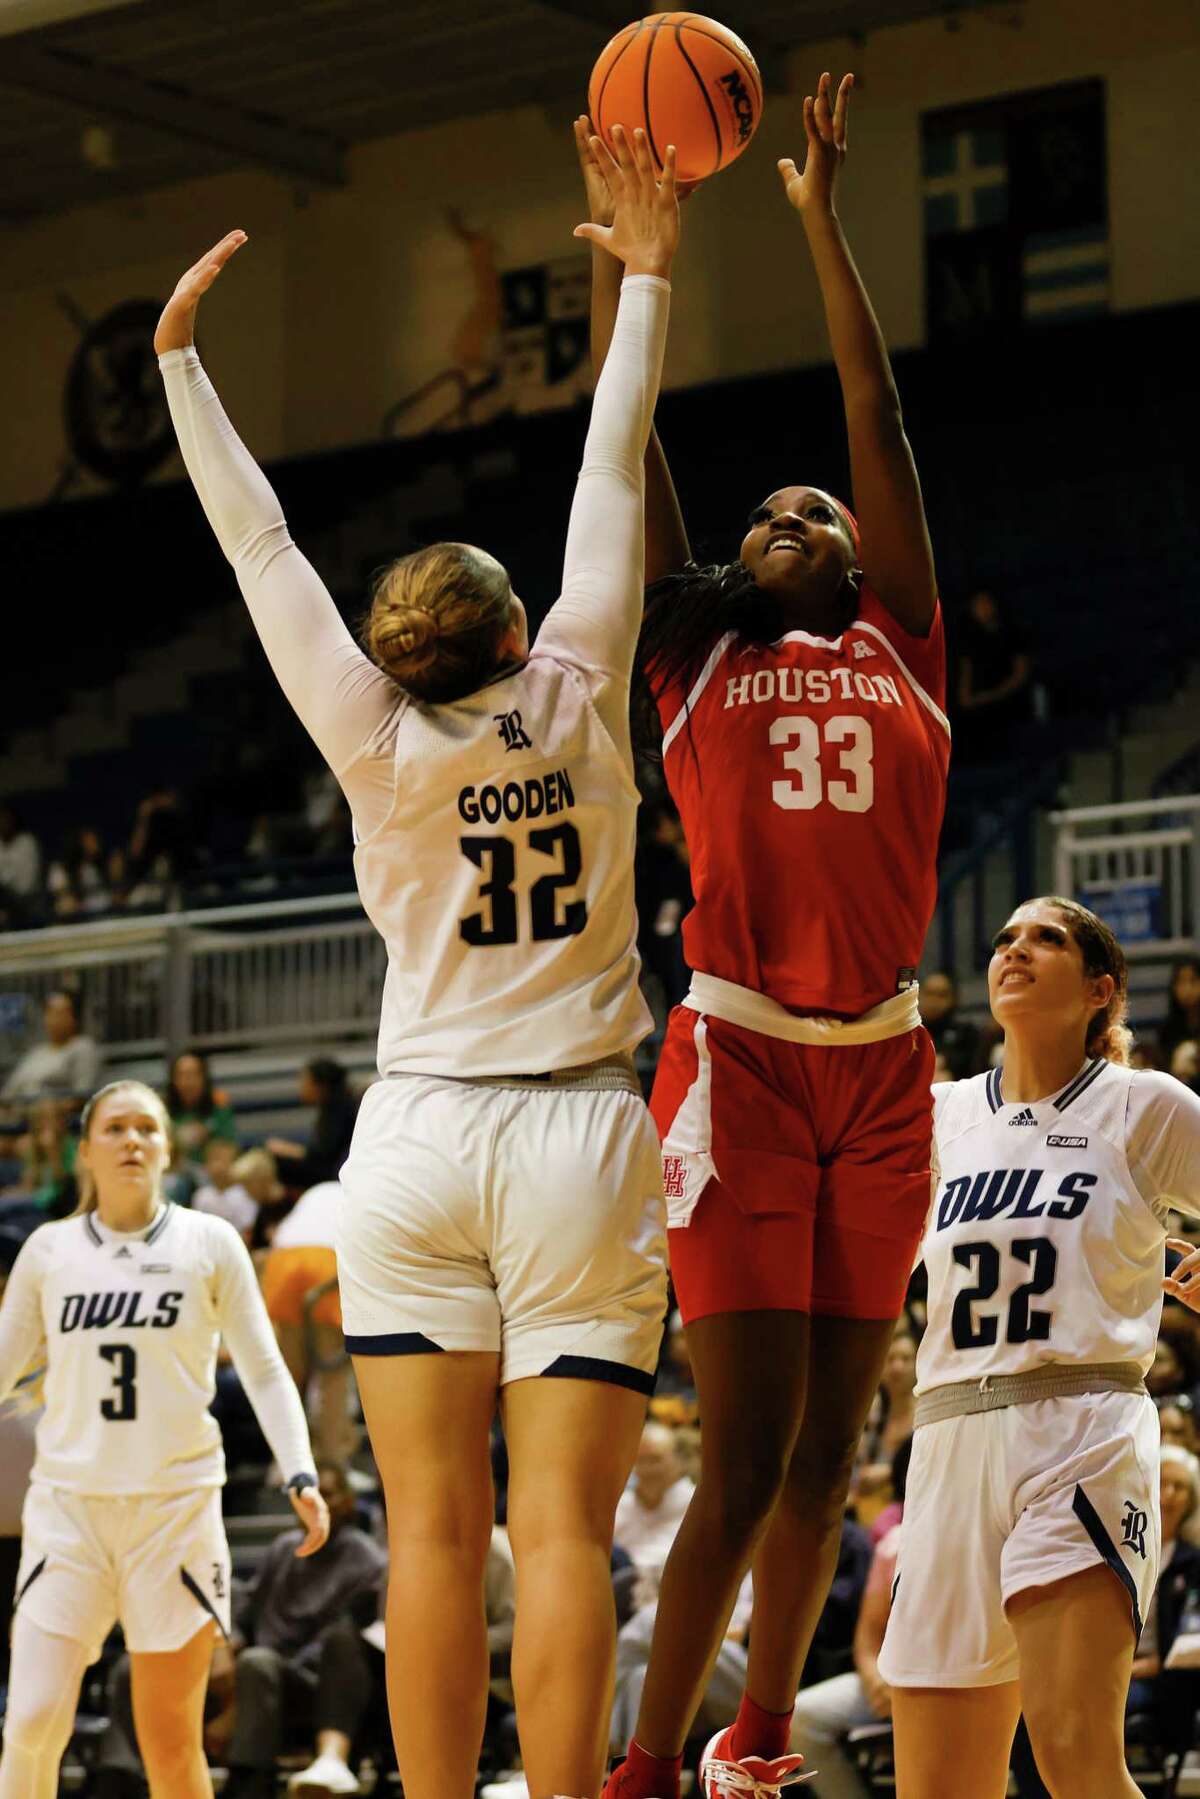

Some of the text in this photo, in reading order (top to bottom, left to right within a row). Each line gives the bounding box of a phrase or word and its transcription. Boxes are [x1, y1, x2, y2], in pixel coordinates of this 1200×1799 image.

[724, 667, 902, 710] HOUSTON
[458, 768, 575, 824] GOODEN
[769, 715, 874, 813] 33
[459, 821, 588, 946] 32
[937, 1169, 1098, 1232] OWLS
[60, 1291, 184, 1334] OWLS
[951, 1237, 1058, 1349] 22
[98, 1343, 137, 1421] 3
